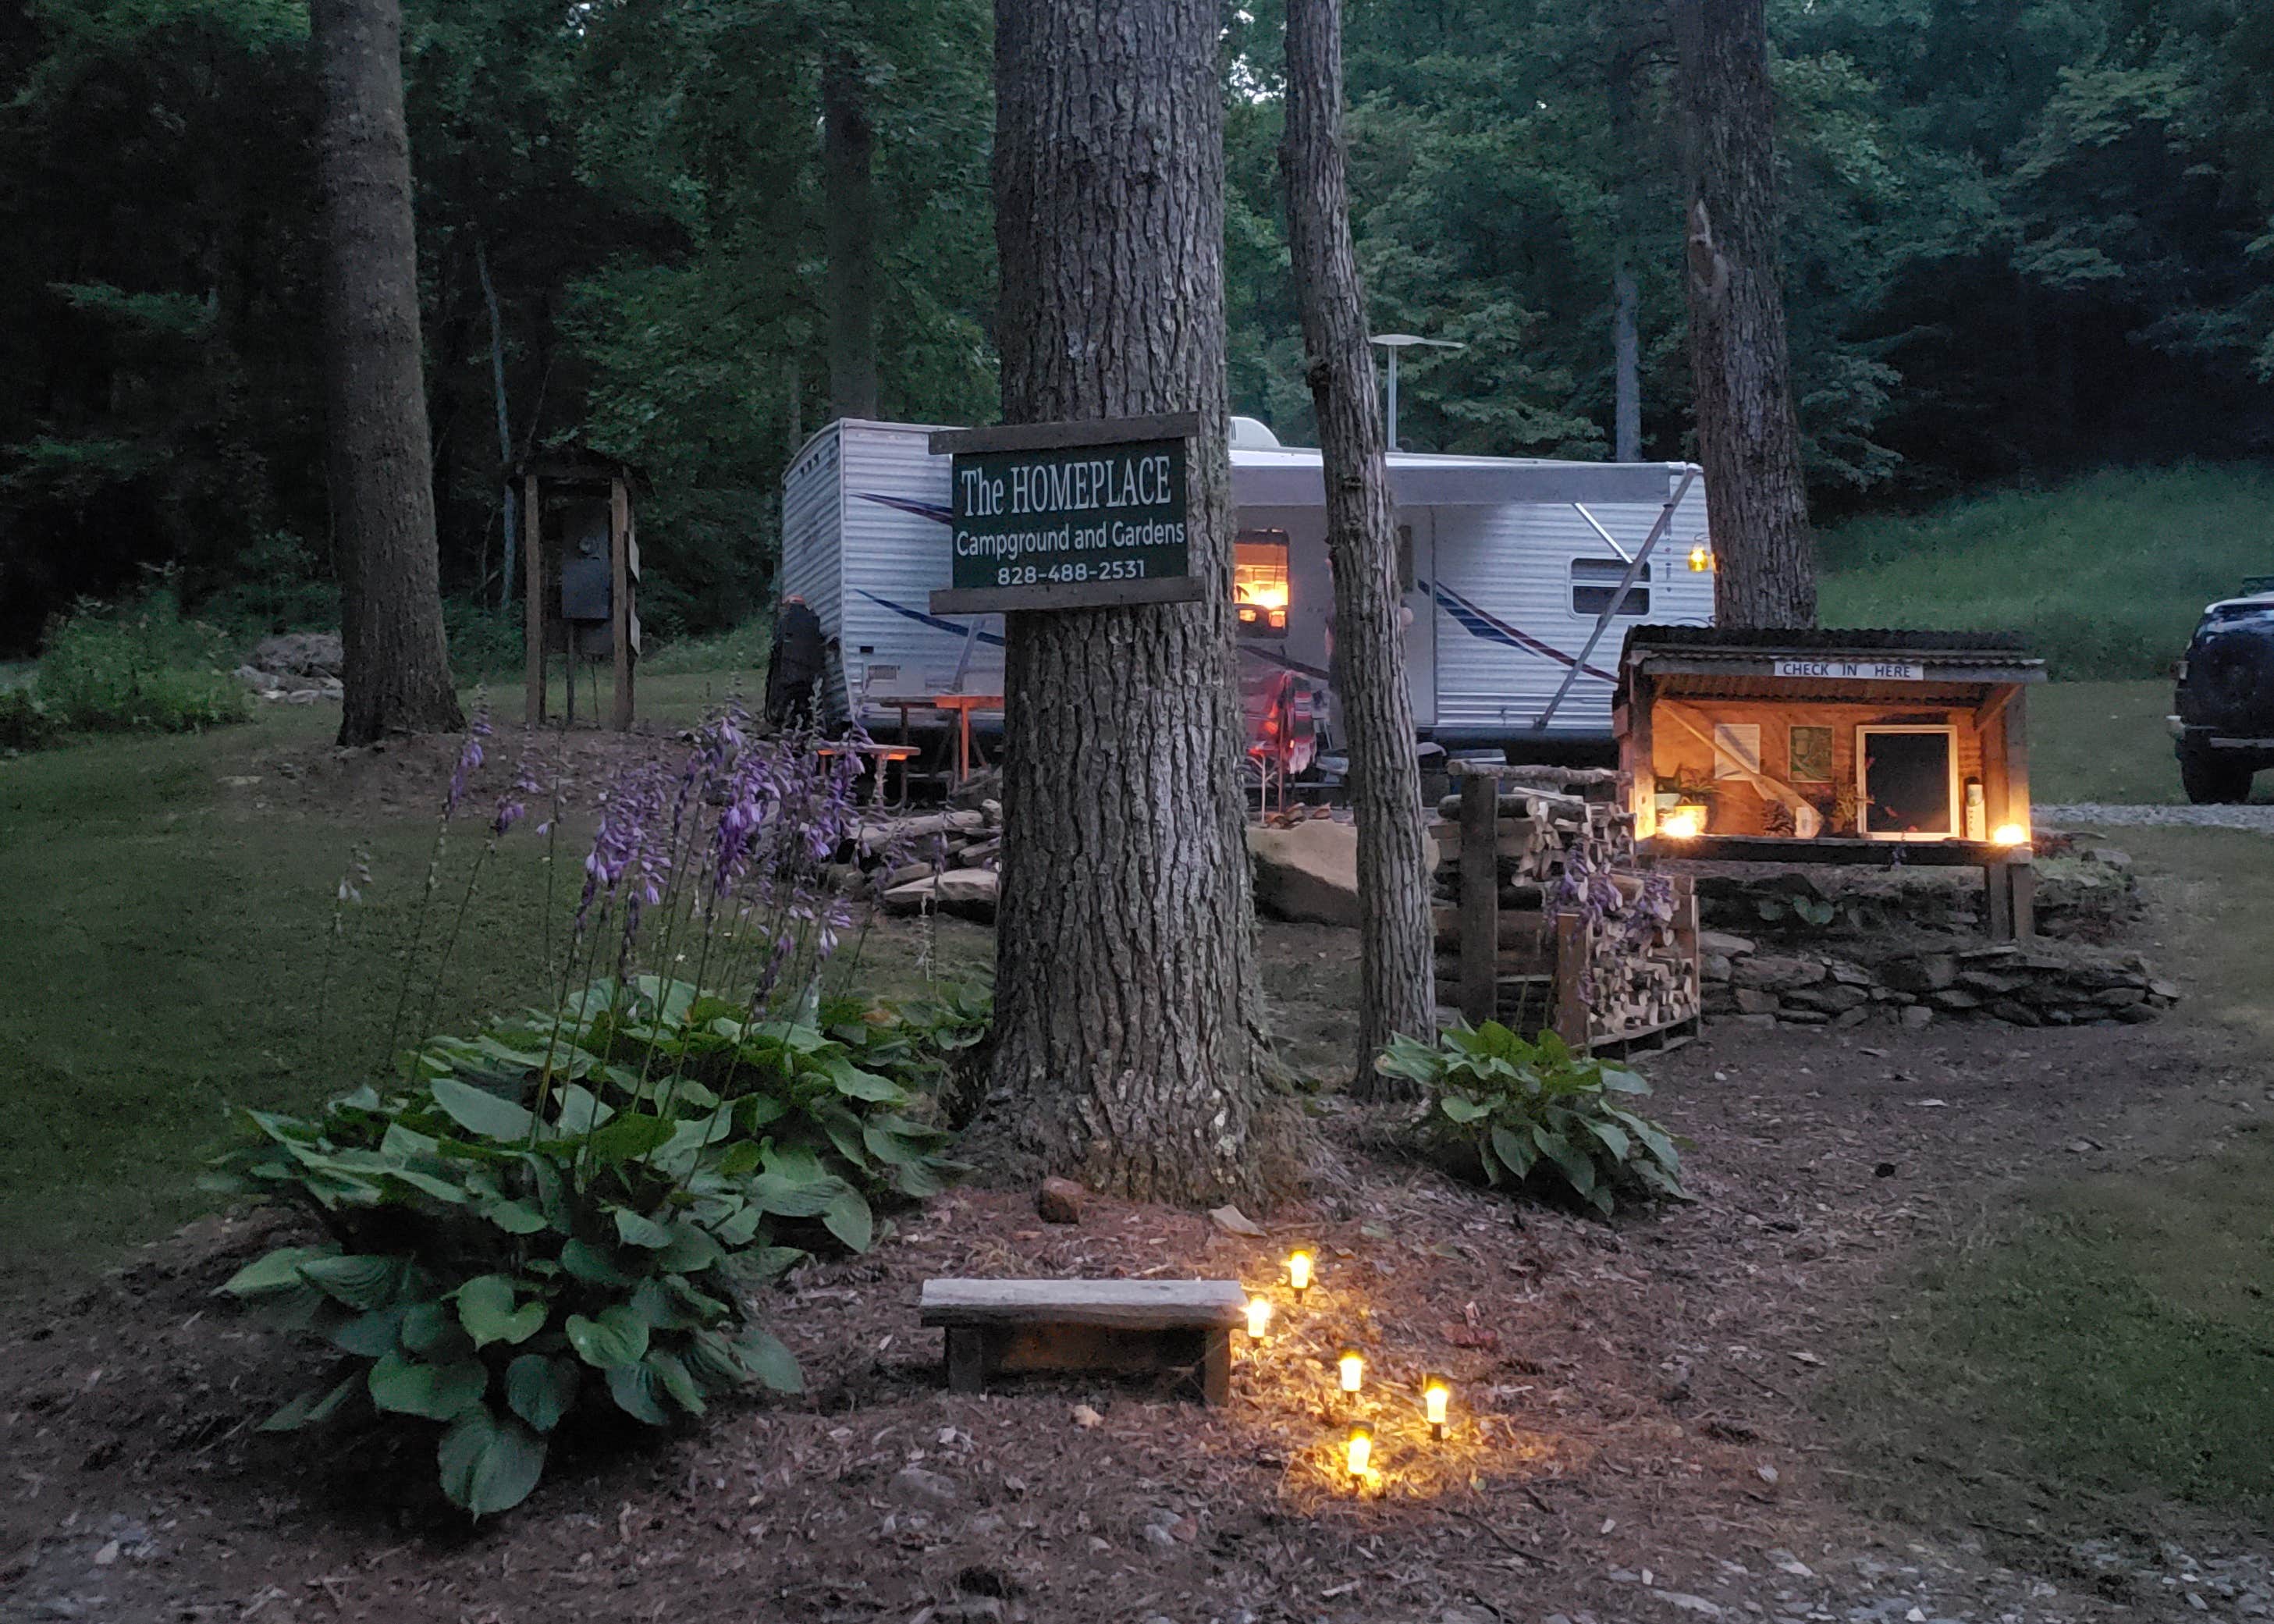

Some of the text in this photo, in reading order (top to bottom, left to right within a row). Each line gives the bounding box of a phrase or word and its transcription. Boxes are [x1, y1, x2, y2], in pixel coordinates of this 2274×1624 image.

[961, 455, 1171, 517] The HOMEPLACE
[957, 518, 1185, 561] Campground and Gardens
[997, 560, 1146, 585] 828-488-2531
[1783, 663, 1910, 677] CHECK IN HERE
